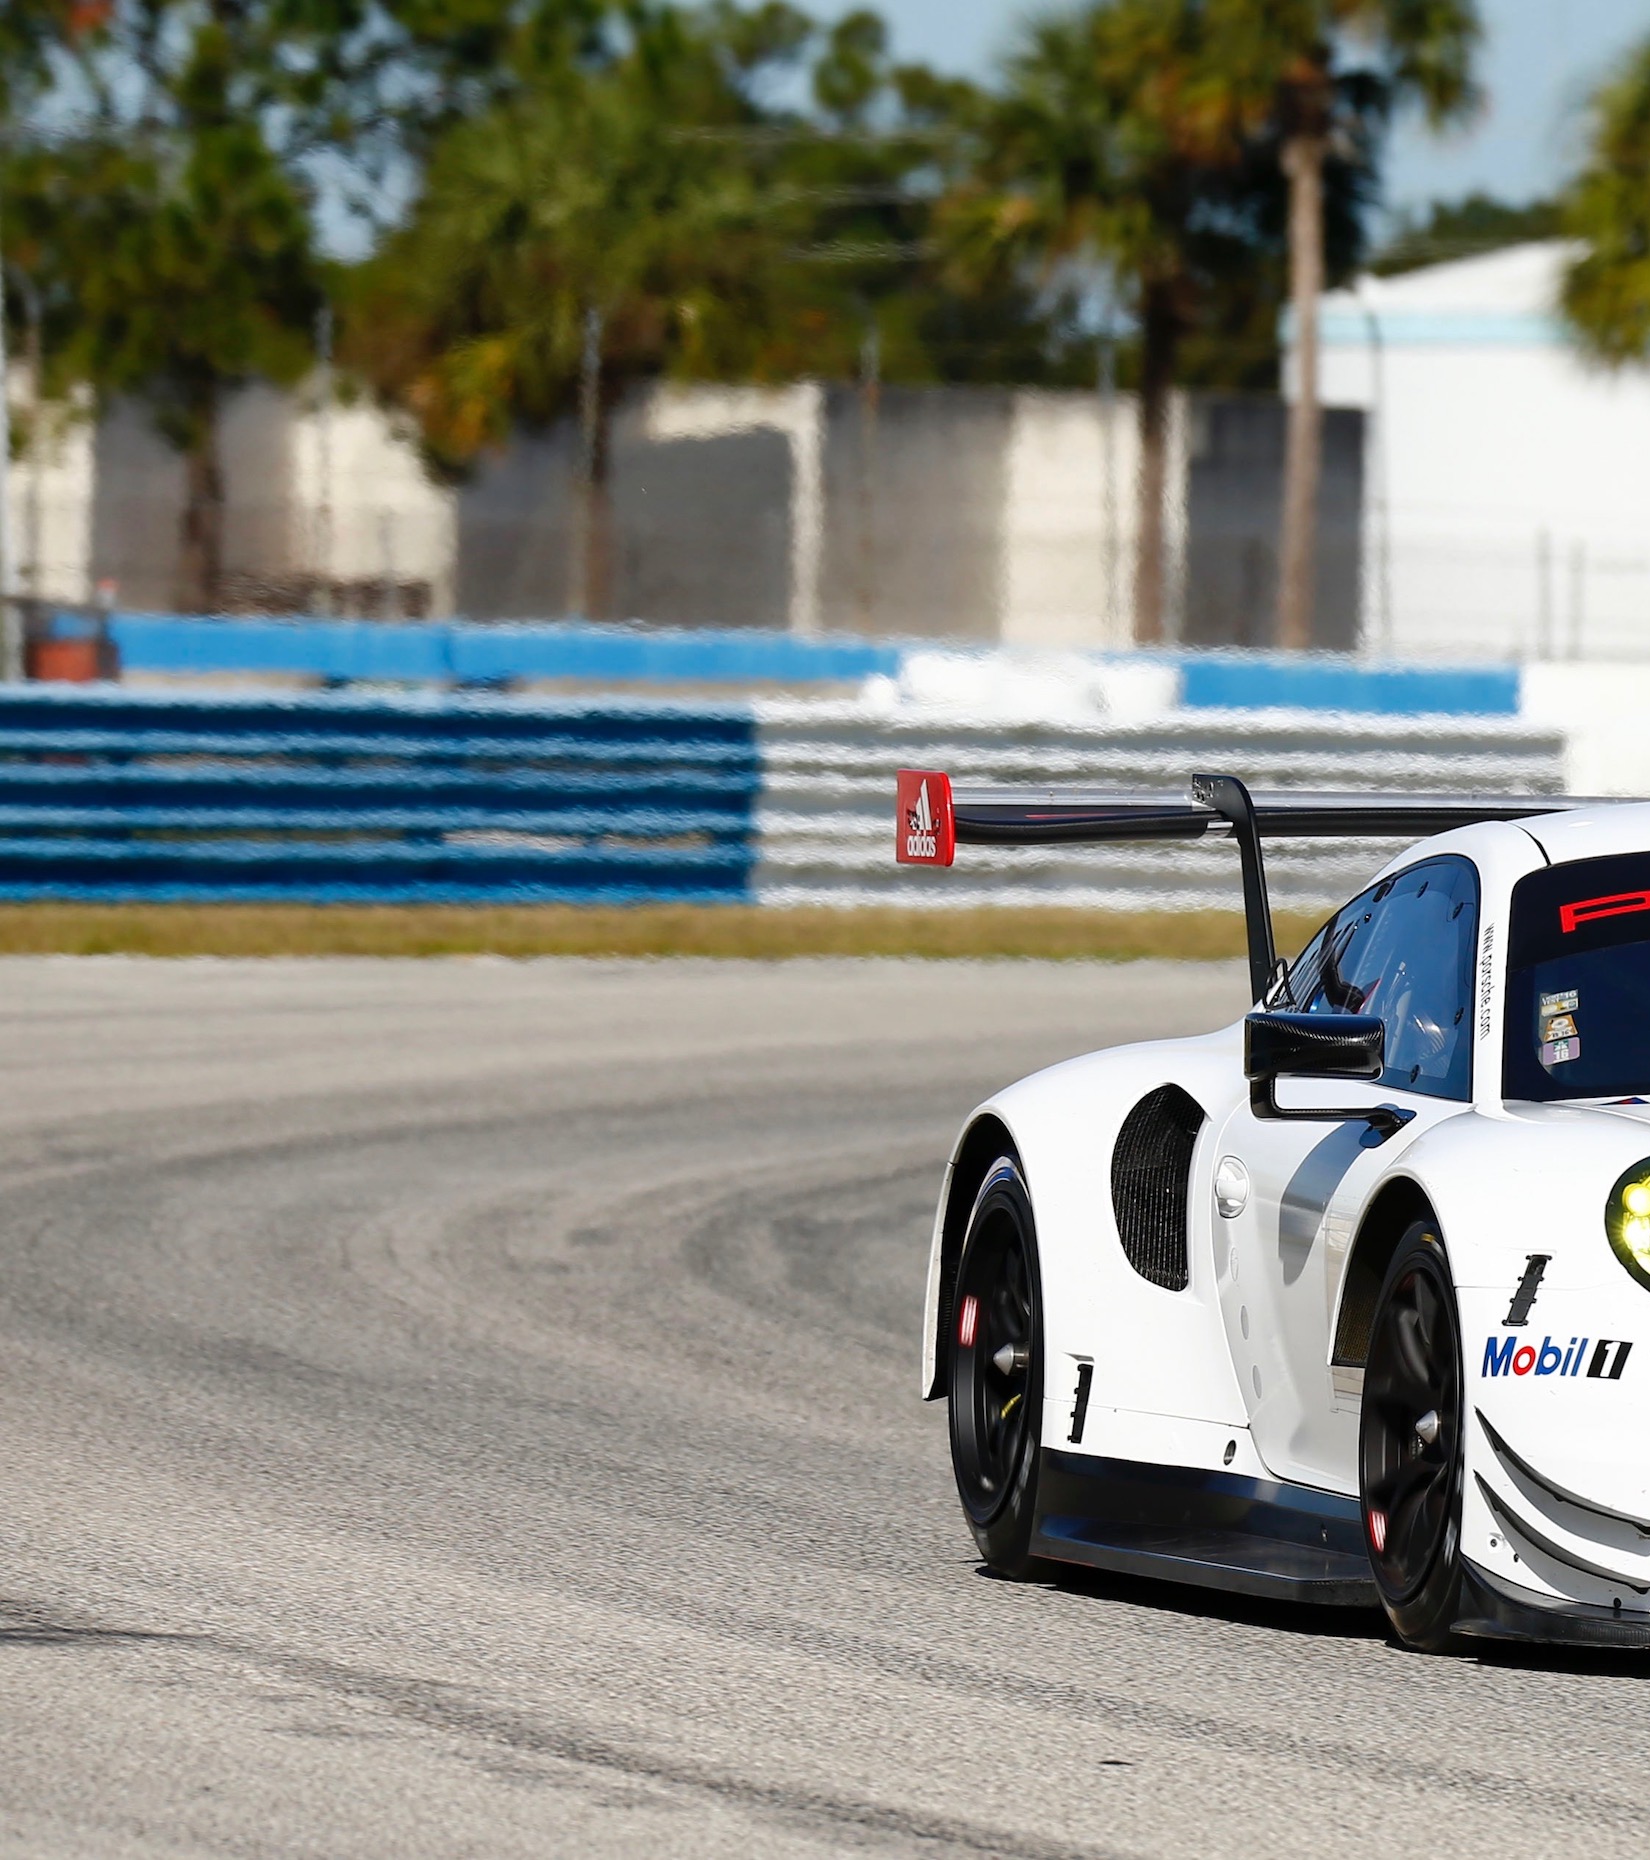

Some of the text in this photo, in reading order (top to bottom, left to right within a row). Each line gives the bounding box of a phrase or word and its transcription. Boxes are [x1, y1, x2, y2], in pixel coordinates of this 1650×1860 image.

[907, 830, 936, 857] adidas
[1479, 922, 1495, 1041] www.porsche.com
[1481, 1336, 1623, 1379] Mobil 1
